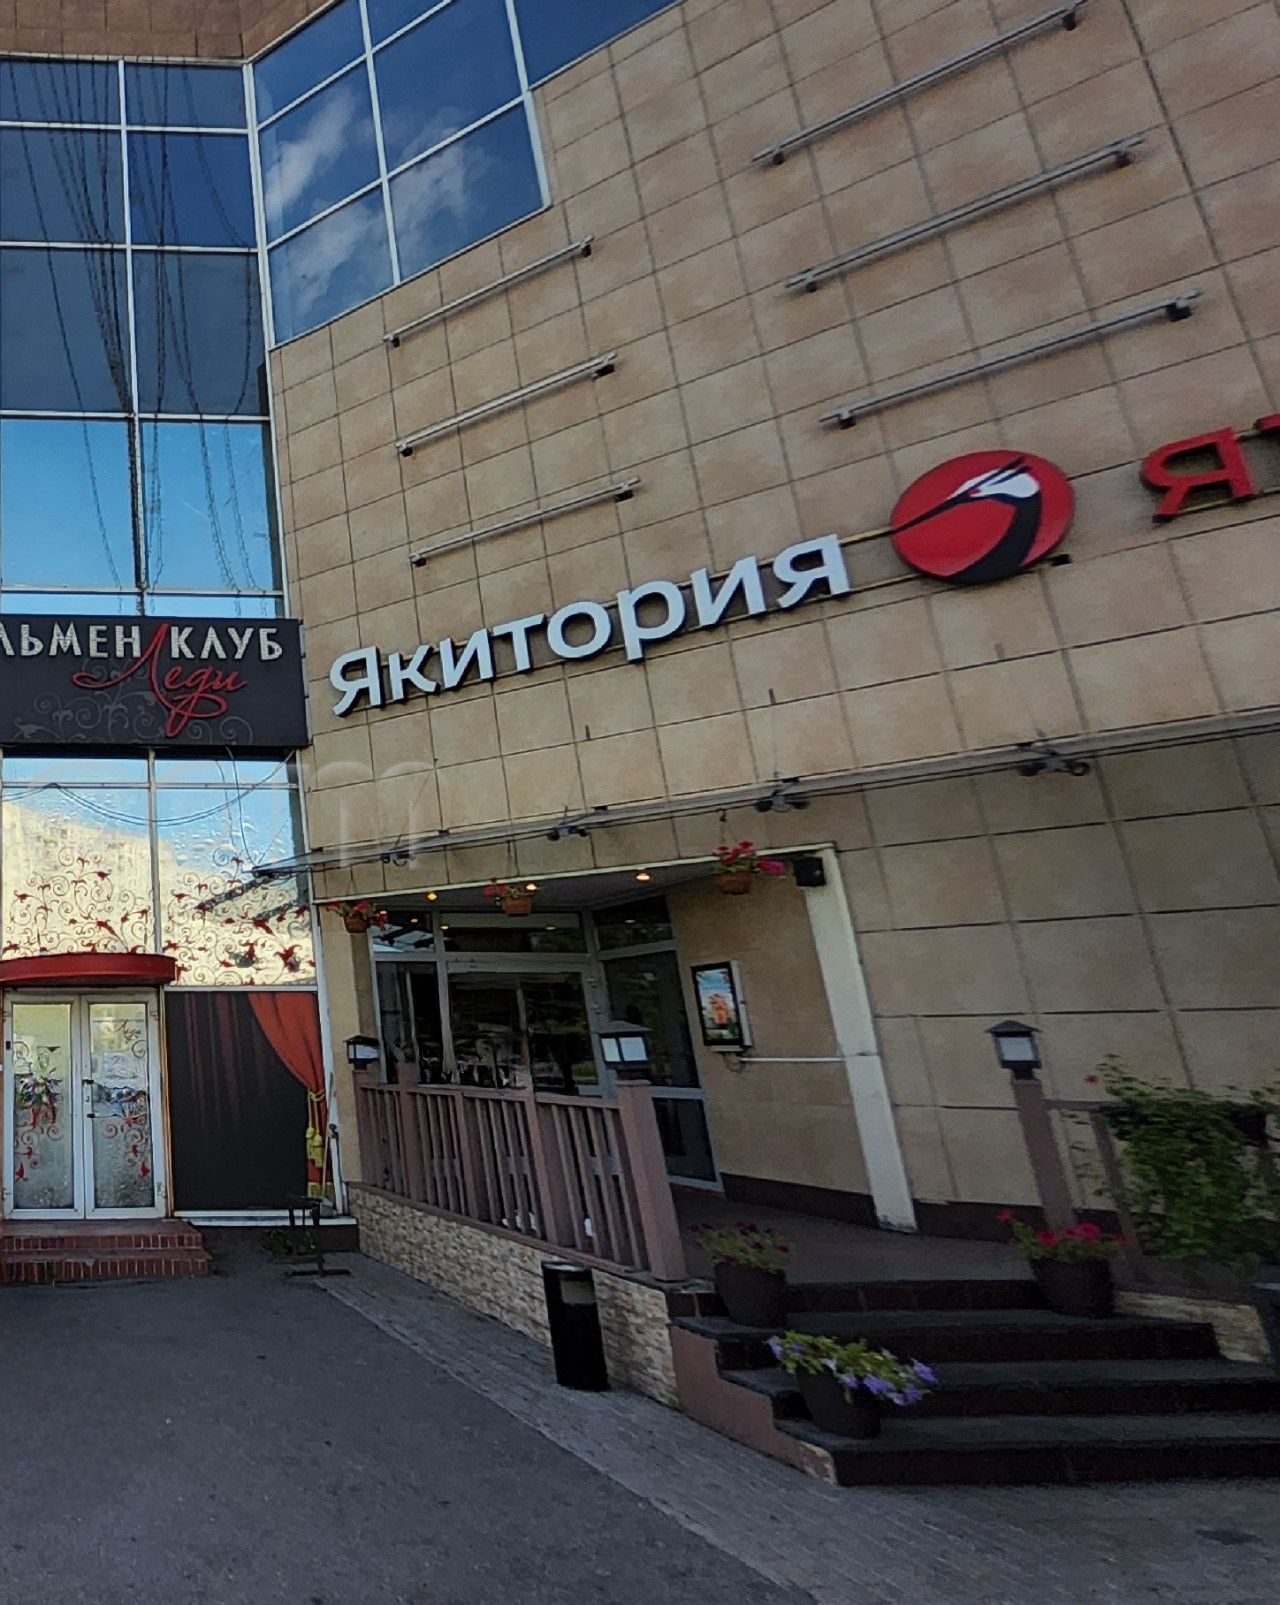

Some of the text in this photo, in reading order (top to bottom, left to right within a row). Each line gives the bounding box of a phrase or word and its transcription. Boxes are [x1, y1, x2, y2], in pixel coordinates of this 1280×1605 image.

[71, 622, 247, 738] Леди
[171, 625, 284, 661] КЛУБ
[329, 534, 851, 717] Якитория
